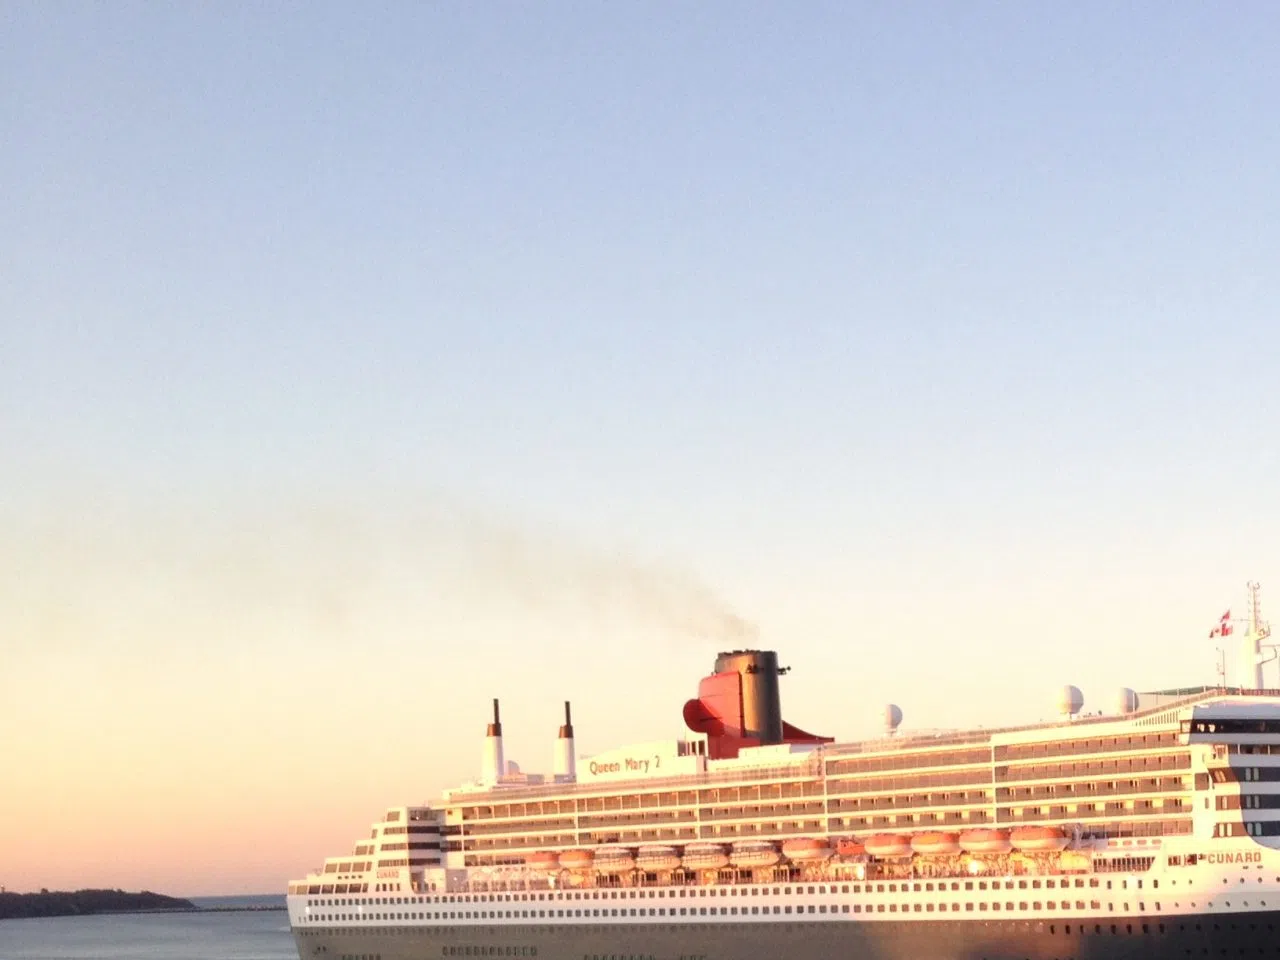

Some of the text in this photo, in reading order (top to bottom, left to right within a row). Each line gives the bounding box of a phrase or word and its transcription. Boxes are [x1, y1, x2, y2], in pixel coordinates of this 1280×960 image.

[589, 755, 660, 775] Queen Mary 2
[1207, 852, 1262, 864] CUNARD
